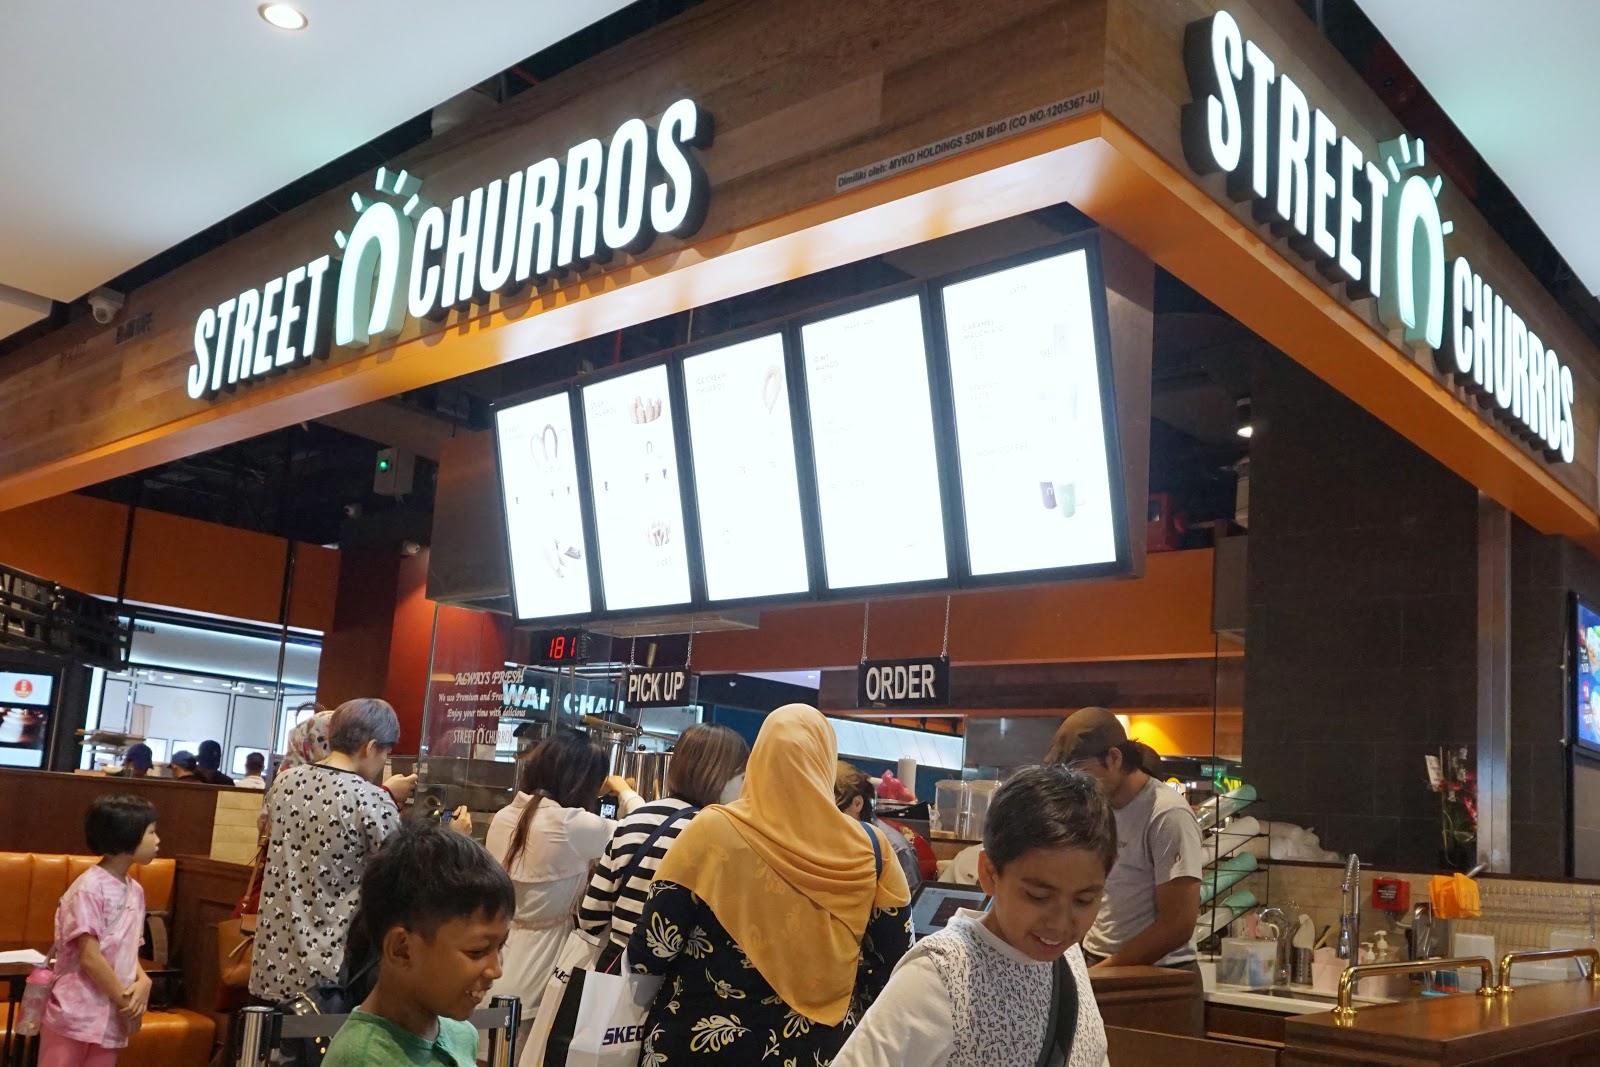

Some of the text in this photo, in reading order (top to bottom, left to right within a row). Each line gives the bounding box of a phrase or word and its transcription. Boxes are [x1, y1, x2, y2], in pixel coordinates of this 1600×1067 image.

[838, 170, 866, 188] Dimiliki
[868, 164, 887, 177] oleh:
[888, 153, 915, 170] MYKO
[916, 137, 962, 161] HOLDINGS
[964, 130, 985, 145] SDN
[986, 121, 1007, 138] BHD
[1008, 115, 1027, 131] (CO
[186, 97, 698, 400] STREET CHURROS
[1208, 10, 1575, 464] STREET CHURROS
[549, 636, 576, 660] 181
[455, 671, 490, 686] ALWAYS
[628, 671, 685, 703] PICK UP
[865, 664, 936, 701] ORDER
[456, 692, 479, 702] Premium
[480, 690, 491, 701] and
[447, 705, 527, 722] Enjoy your time with delicious
[453, 729, 513, 744] STREET CHURROS
